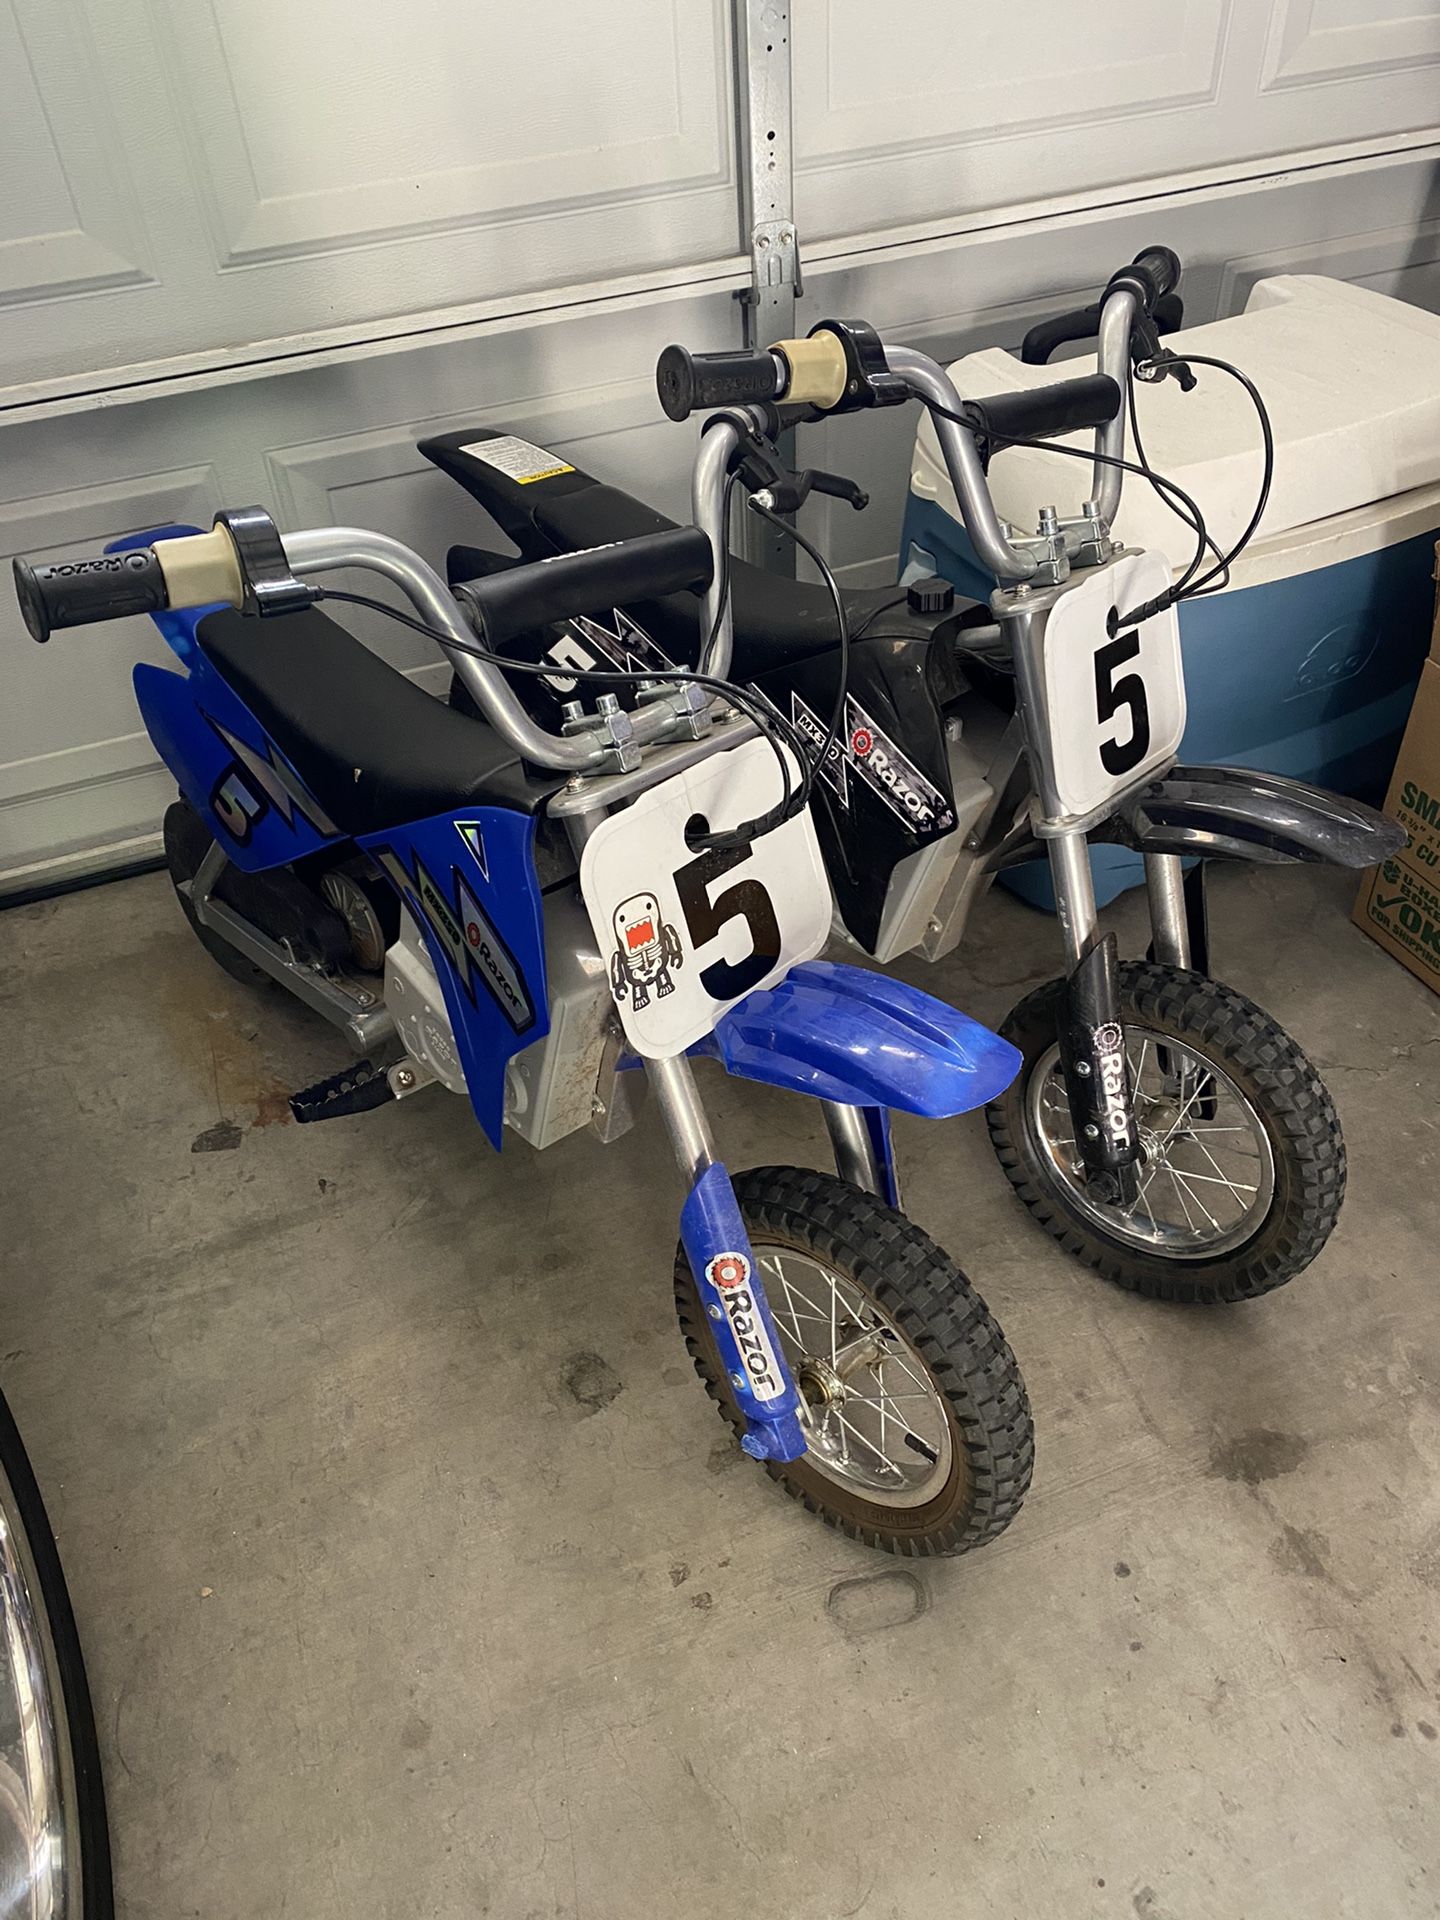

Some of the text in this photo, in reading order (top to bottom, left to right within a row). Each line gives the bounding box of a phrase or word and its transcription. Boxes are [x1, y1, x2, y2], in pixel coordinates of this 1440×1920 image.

[43, 556, 122, 580] Razor
[539, 634, 598, 692] 5
[1094, 628, 1150, 776] 5
[798, 714, 840, 760] MX30
[214, 773, 260, 836] 5
[868, 748, 935, 821] Razor
[1401, 781, 1440, 831] SM
[1416, 843, 1440, 867] CU
[672, 840, 781, 1001] 5
[1372, 906, 1391, 927] FOR
[479, 942, 523, 1008] Razor
[1101, 1053, 1130, 1147] Razor
[724, 1290, 776, 1392] Razor
